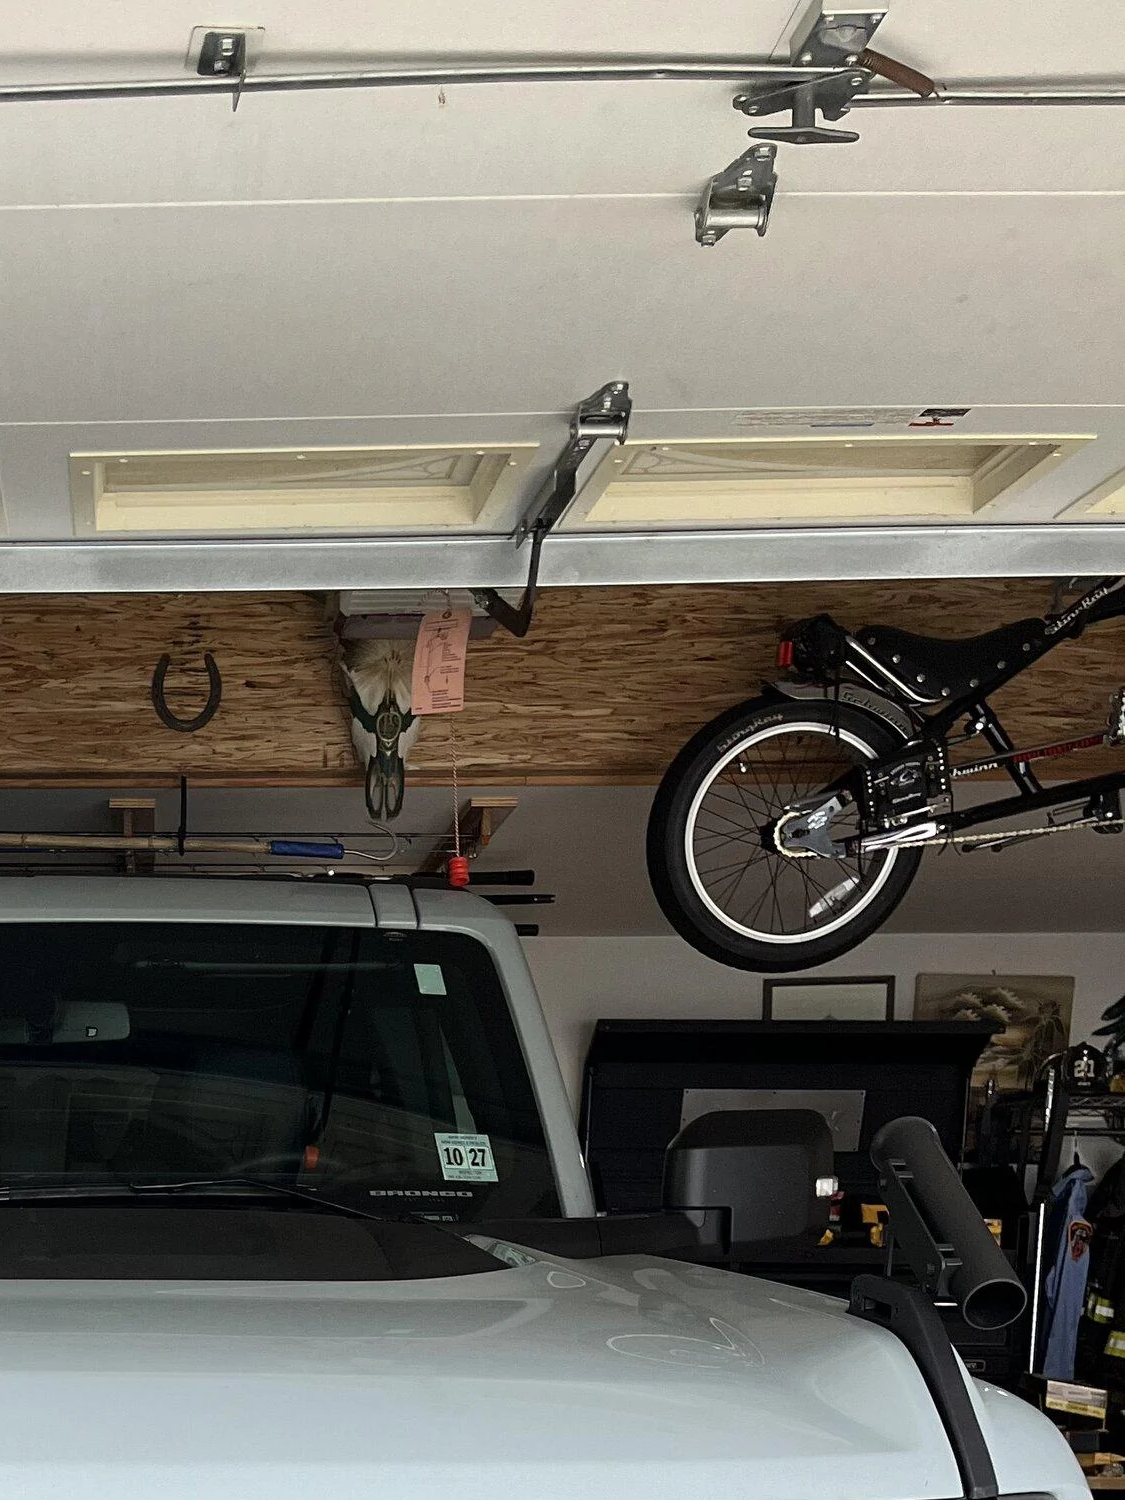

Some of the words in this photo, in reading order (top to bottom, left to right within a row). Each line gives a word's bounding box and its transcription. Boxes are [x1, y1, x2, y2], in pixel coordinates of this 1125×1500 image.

[443, 1147, 464, 1166] 10
[468, 1148, 486, 1167] 27
[369, 1190, 474, 1198] BRONCO
